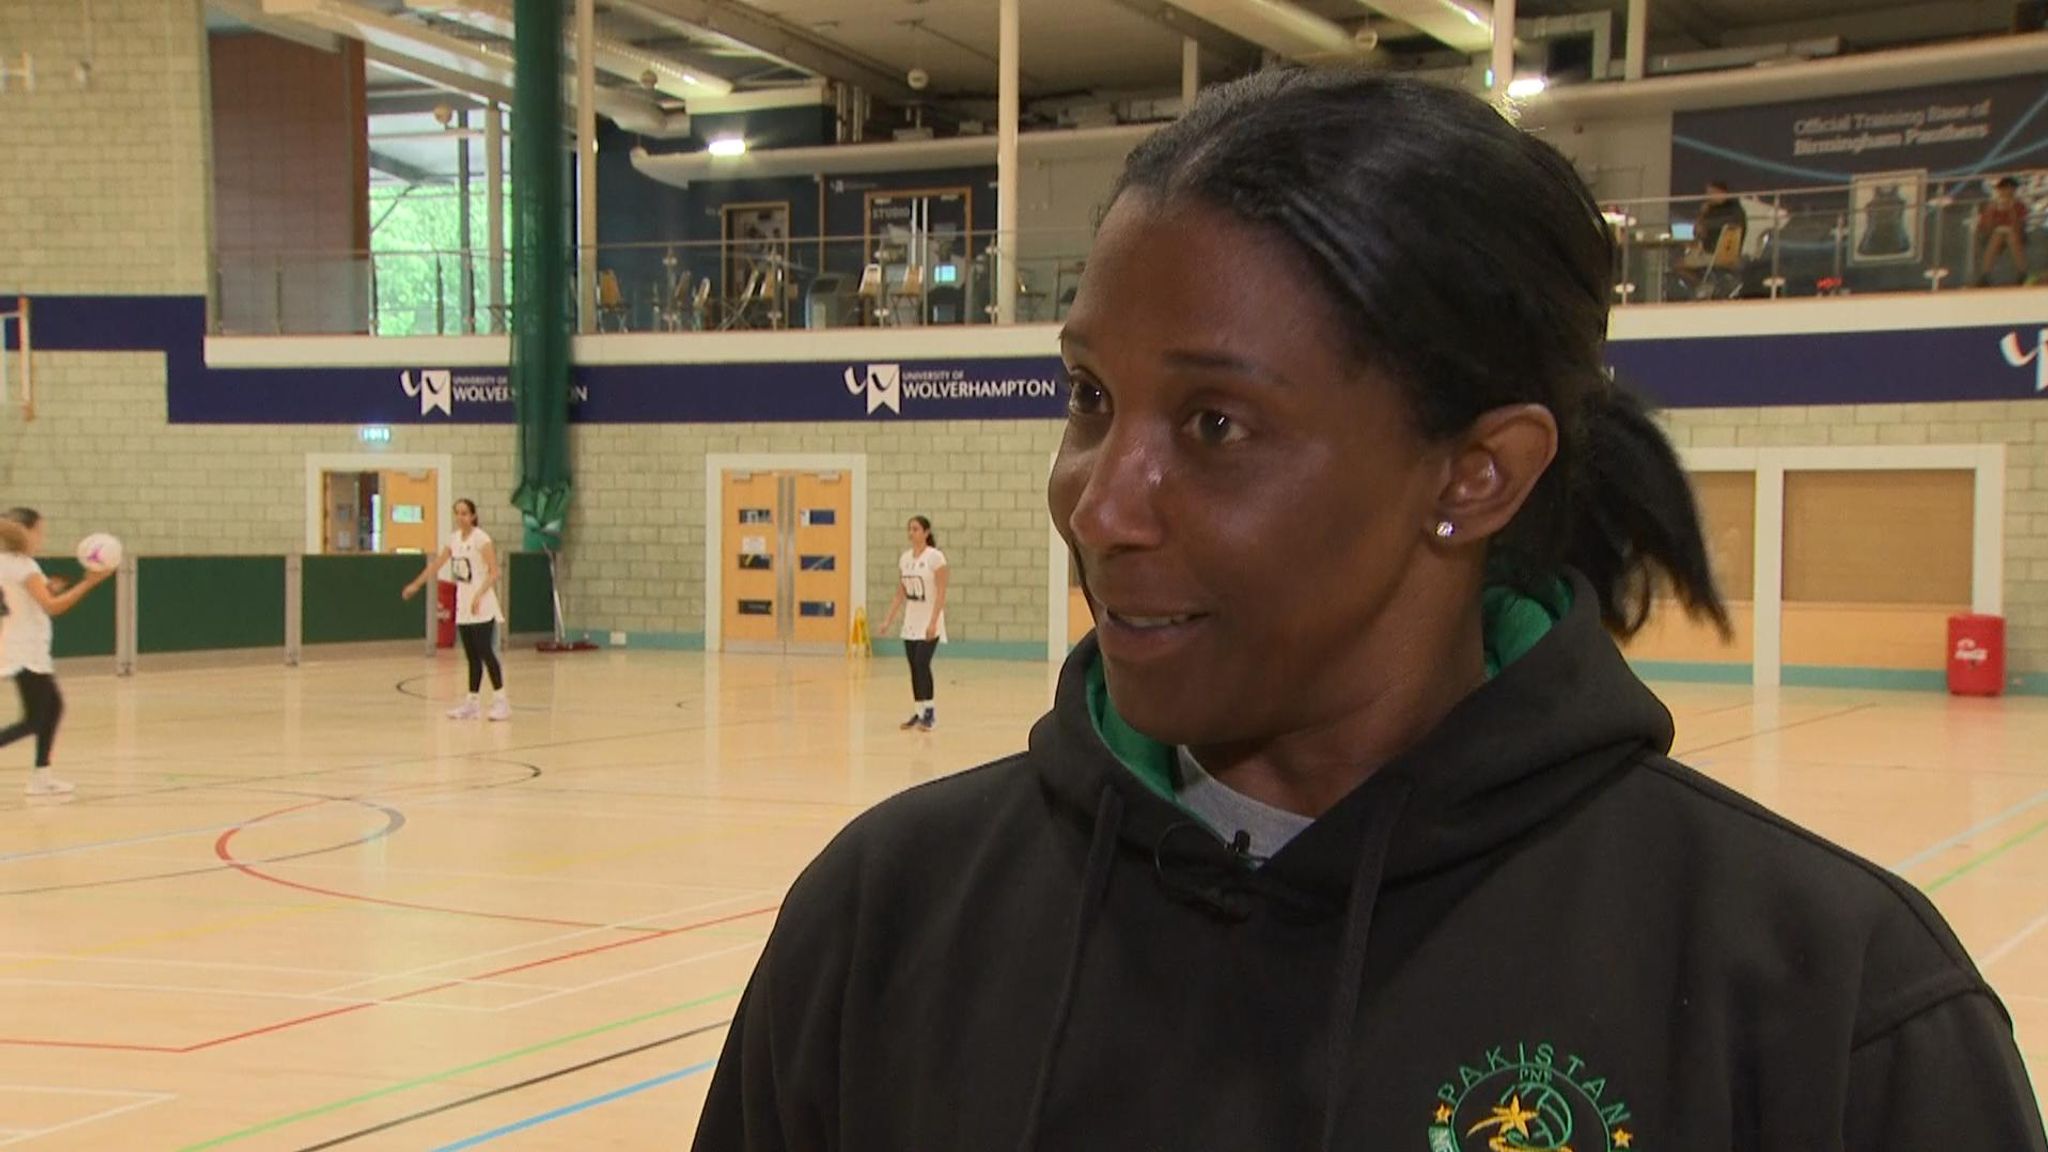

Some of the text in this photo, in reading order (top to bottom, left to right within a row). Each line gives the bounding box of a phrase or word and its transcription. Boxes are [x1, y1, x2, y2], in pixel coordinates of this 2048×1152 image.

[902, 369, 964, 380] UNIVERSITY OF
[903, 380, 1056, 398] WOLVERHAMPTON
[1437, 1041, 1631, 1124] PAKISTAN
